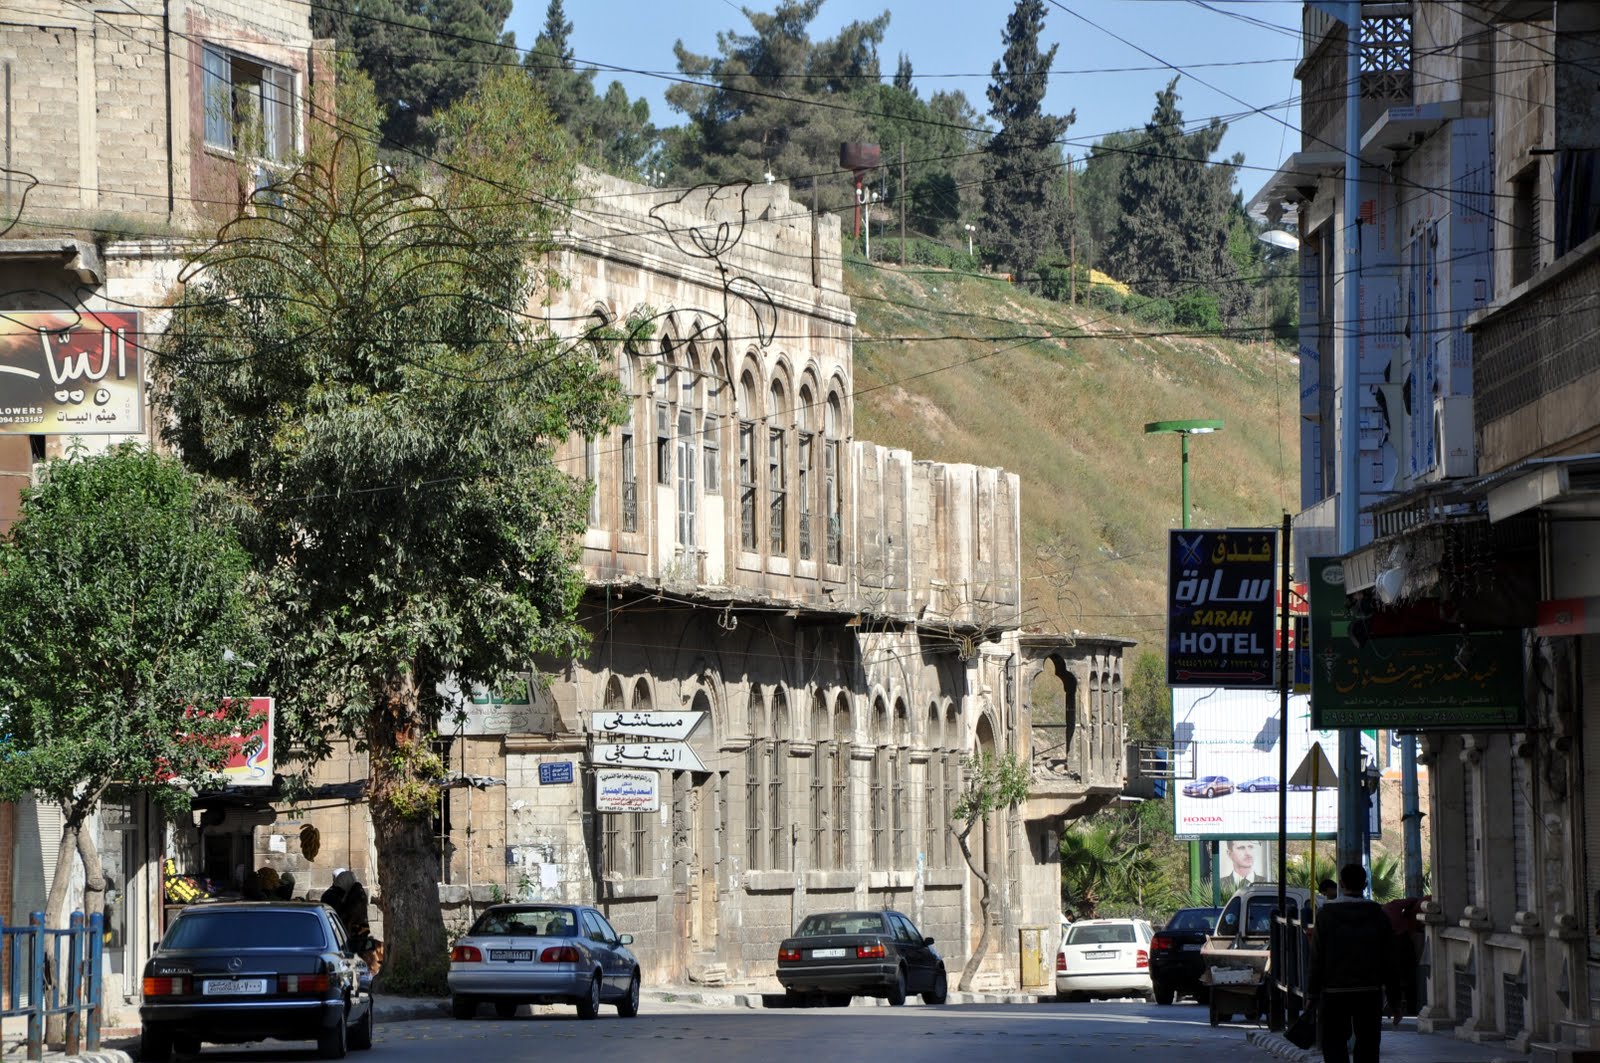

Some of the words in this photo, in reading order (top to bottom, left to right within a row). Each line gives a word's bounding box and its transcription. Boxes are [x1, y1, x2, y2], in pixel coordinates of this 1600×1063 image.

[15, 416, 44, 424] 233147
[57, 410, 93, 424] البيات
[95, 408, 117, 424] هيثم
[1211, 534, 1271, 565] فندق
[1176, 569, 1271, 606] سارة
[1191, 610, 1253, 627] SARAH
[1179, 632, 1265, 654] HOTEL
[603, 713, 683, 730] مستشفى
